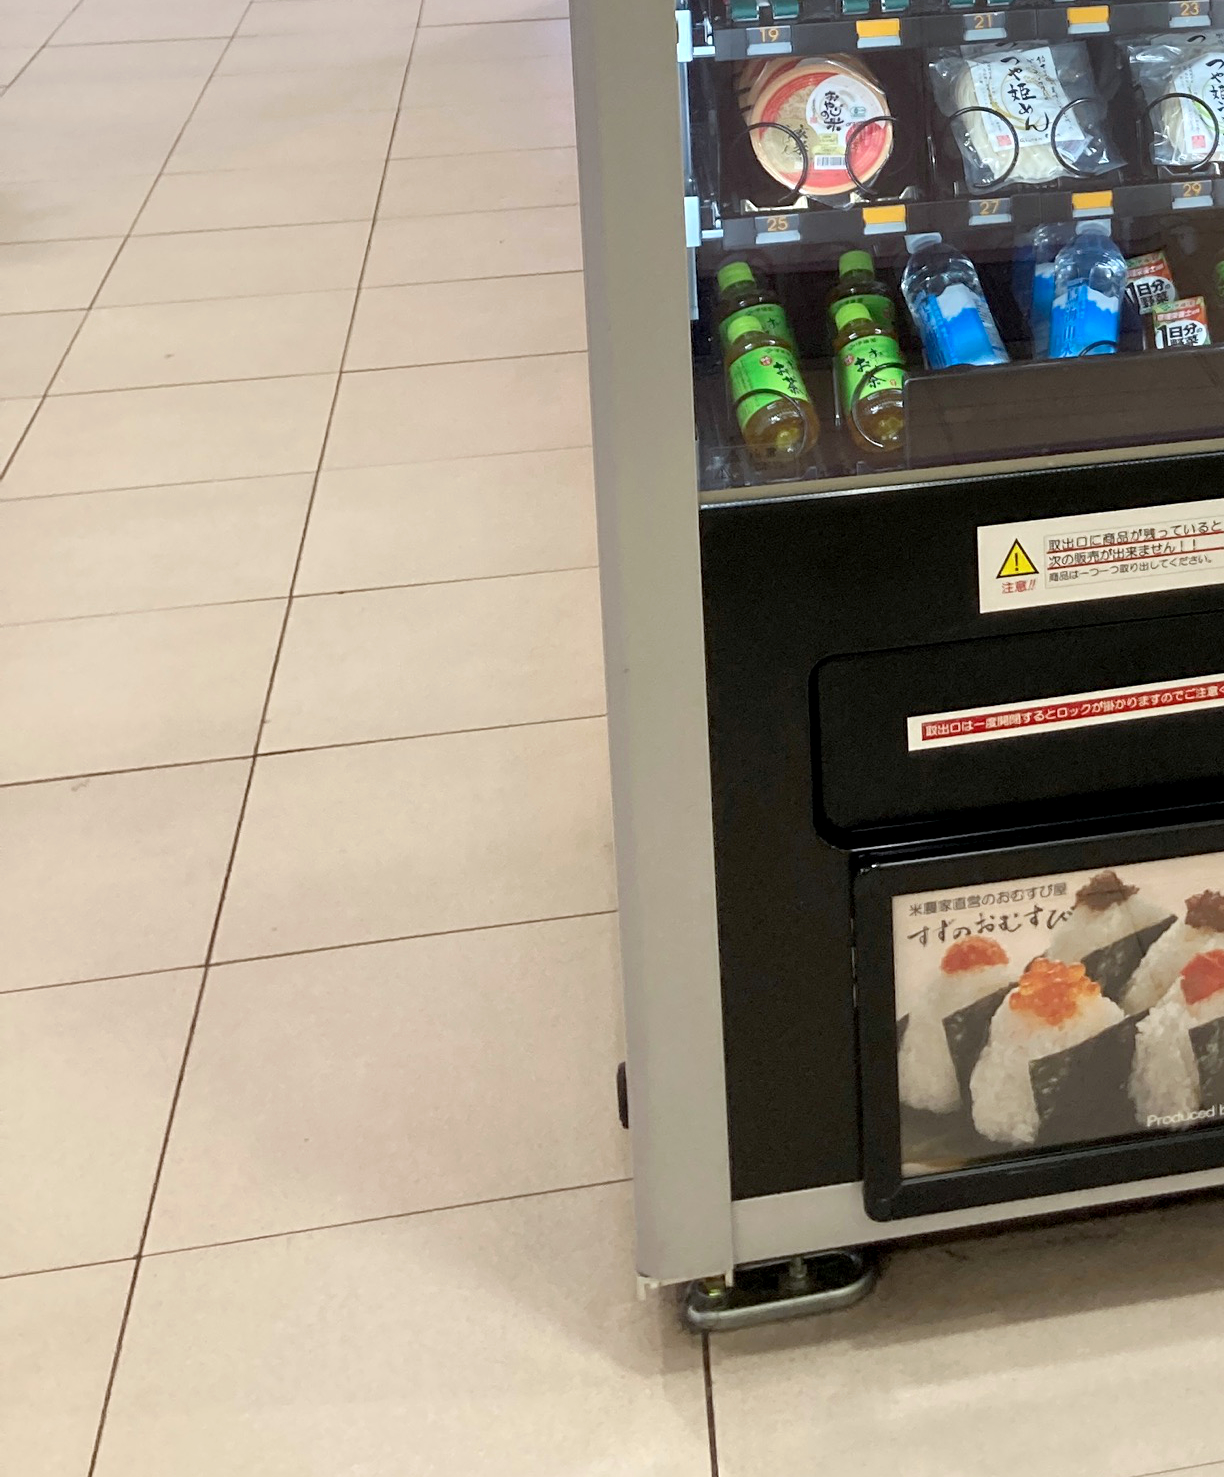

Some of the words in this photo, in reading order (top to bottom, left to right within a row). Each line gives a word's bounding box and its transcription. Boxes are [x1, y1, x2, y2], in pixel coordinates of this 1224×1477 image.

[1180, 2, 1199, 16] 23
[973, 15, 992, 29] 21
[760, 27, 779, 42] 19
[1001, 56, 1049, 133] つや姫めん
[1183, 183, 1203, 198] 29
[979, 200, 999, 215] 27
[767, 216, 788, 232] 25
[1157, 323, 1203, 348] 1日分の
[1048, 520, 1222, 549] 取出口に商品が残っていると
[1048, 539, 1197, 567] 次の販売が出来ません！！
[1049, 555, 1213, 582] 商品は一つ一つ取り出してください。
[908, 882, 1067, 917] 米農家直営のおむすび屋
[907, 904, 1076, 947] すずのおむすび
[1147, 1106, 1215, 1127] Produced
